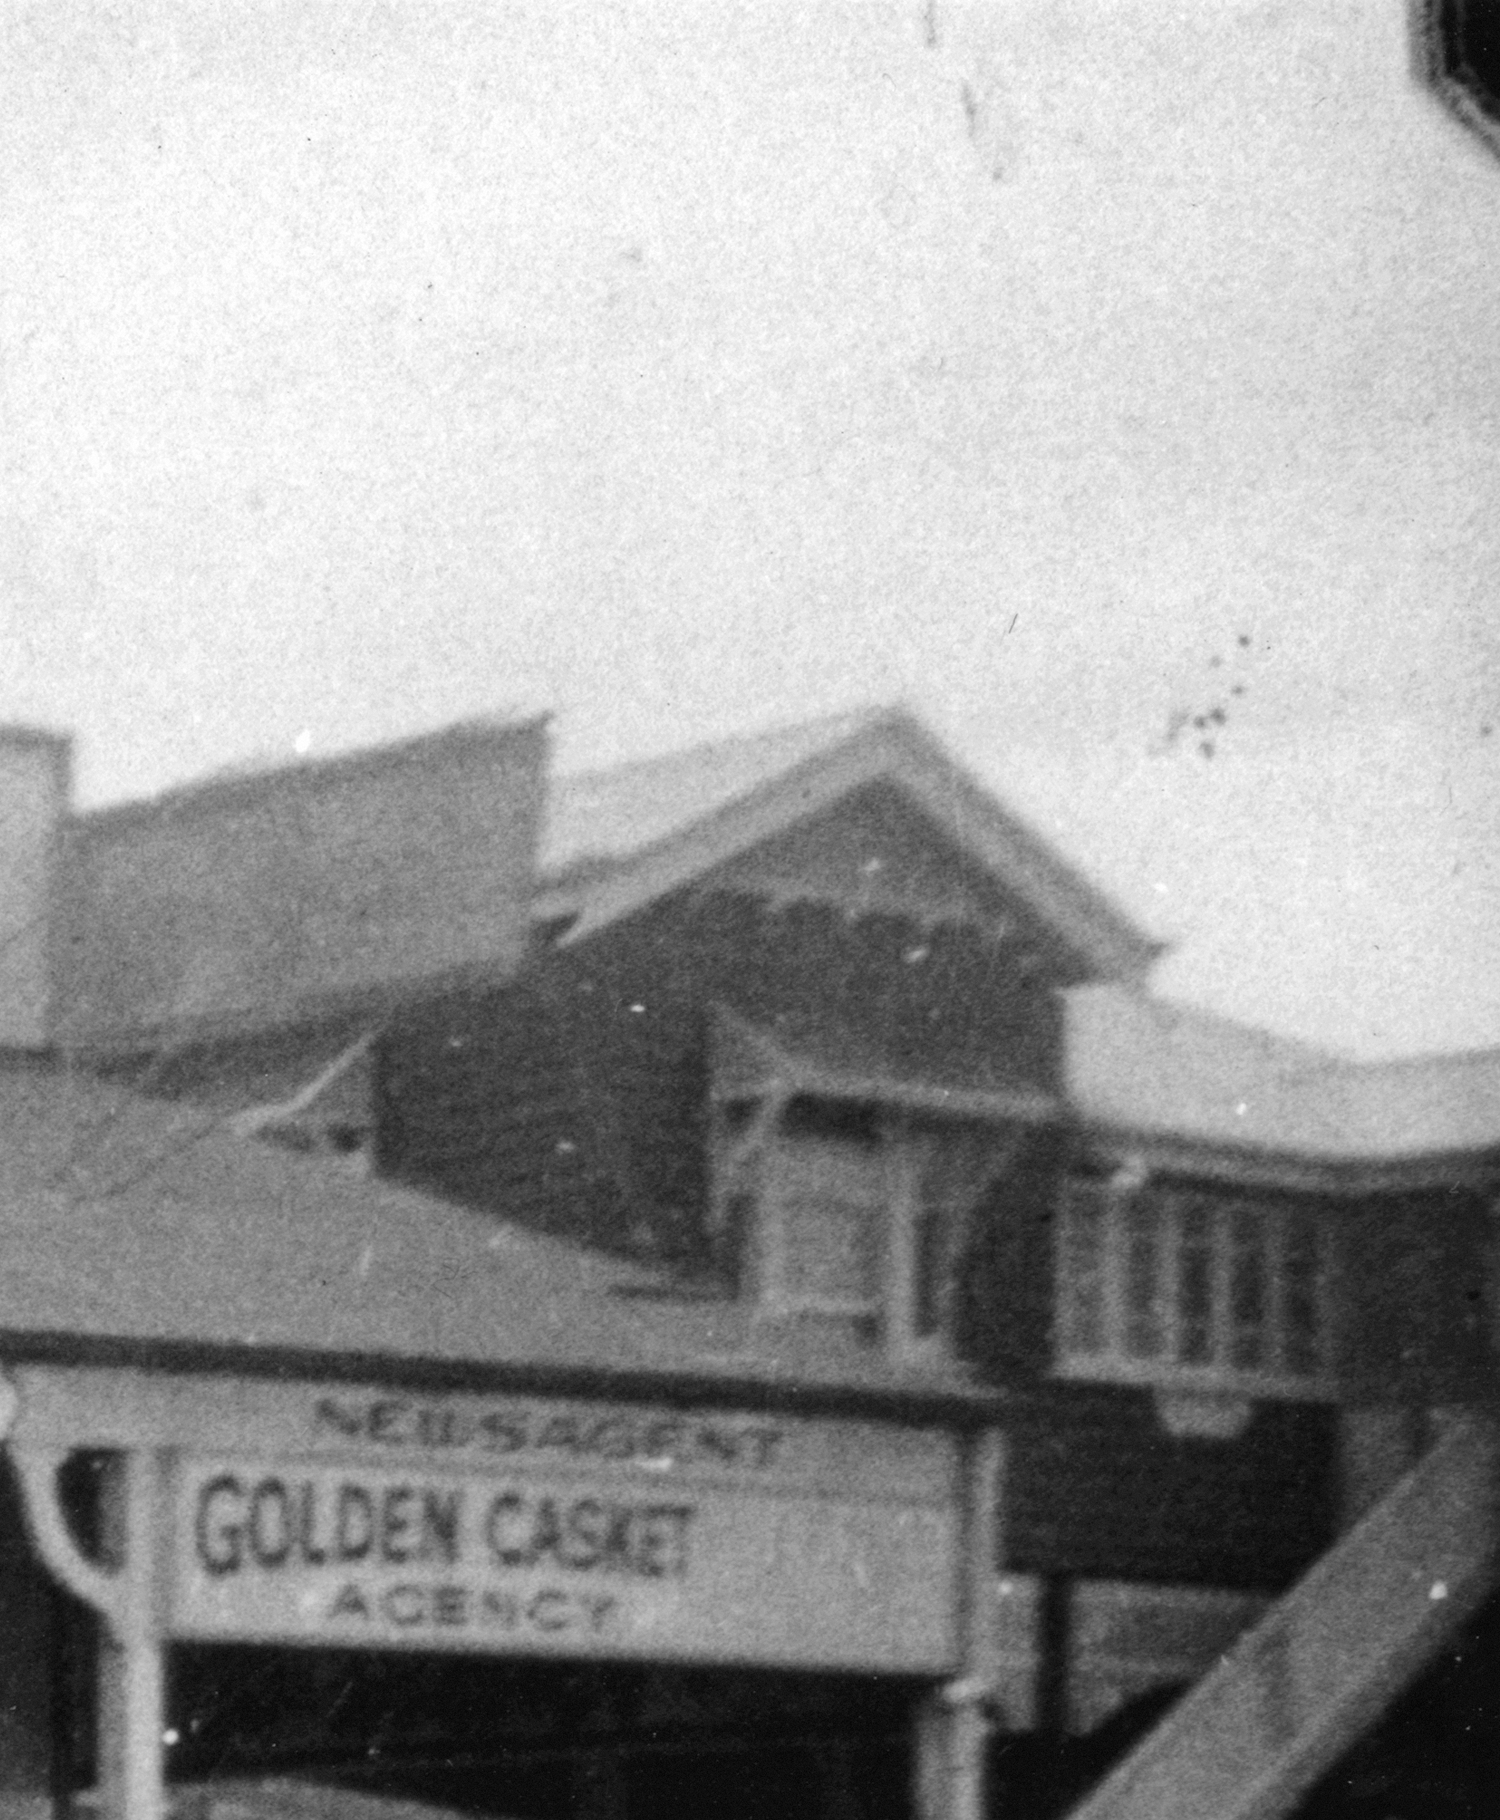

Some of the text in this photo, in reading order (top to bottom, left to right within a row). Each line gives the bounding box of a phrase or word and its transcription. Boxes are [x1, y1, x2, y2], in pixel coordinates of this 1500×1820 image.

[196, 1473, 696, 1580] GOLDEN CASKET
[328, 1583, 614, 1634] AGENCY
